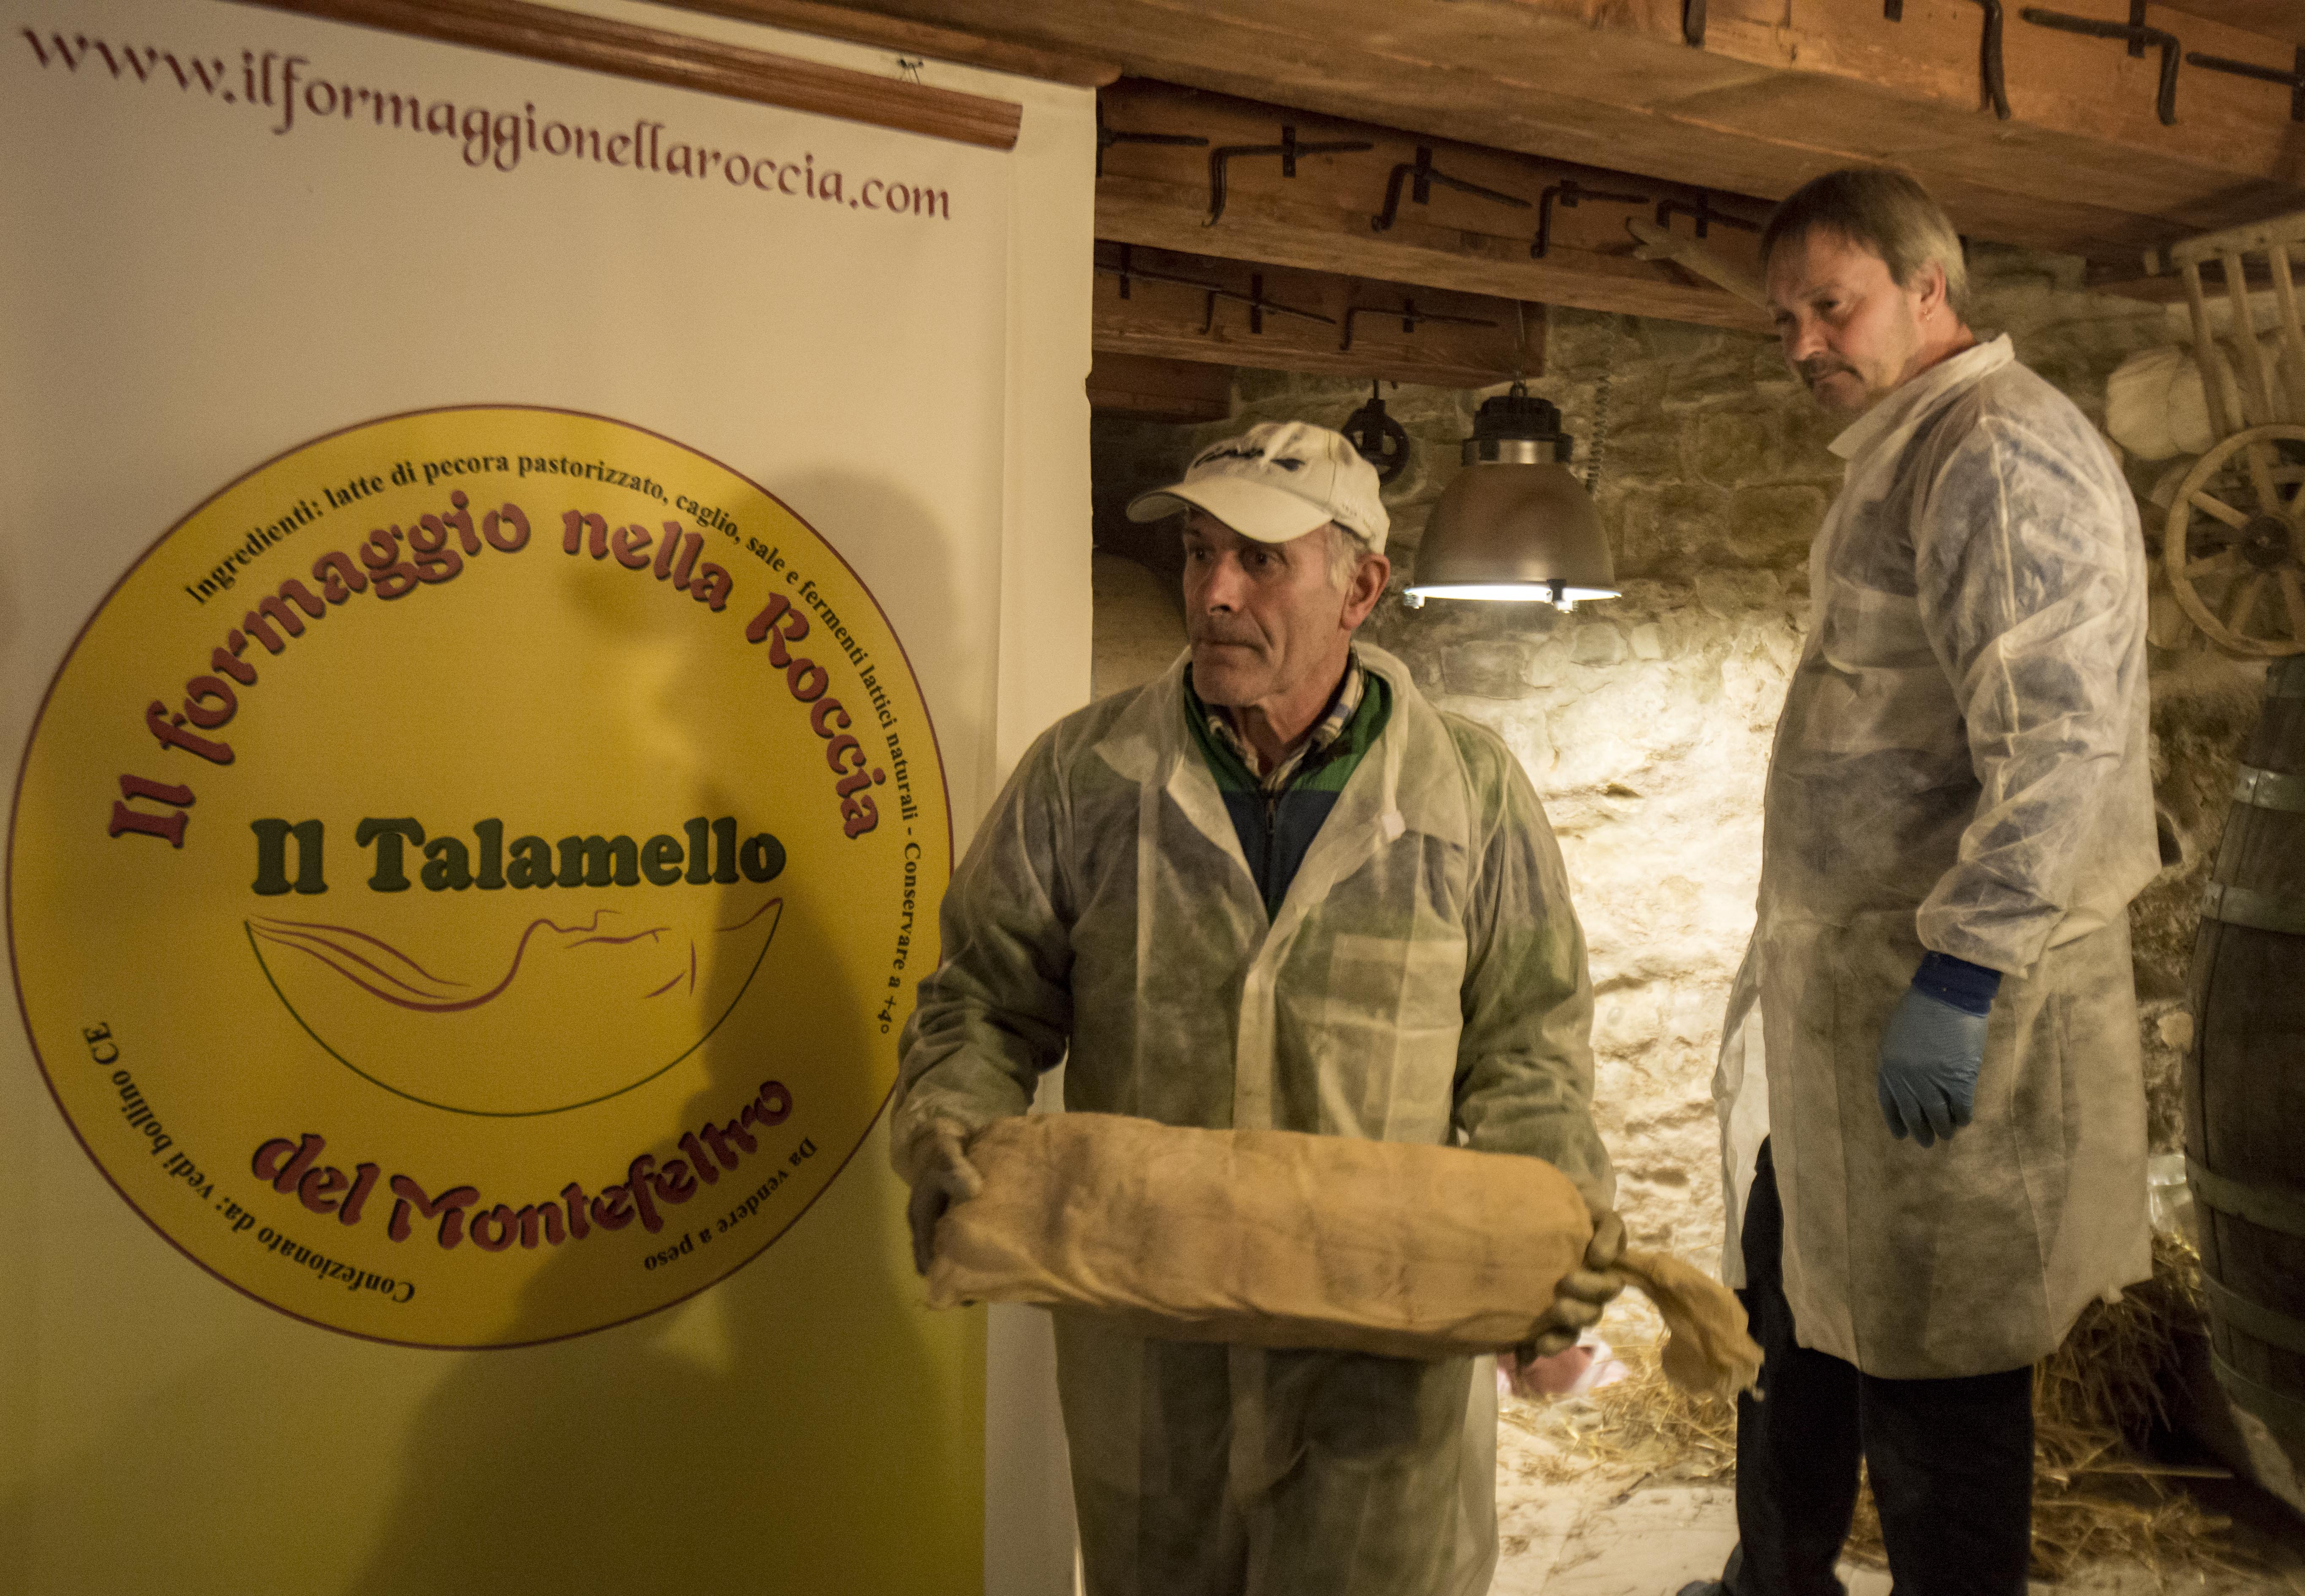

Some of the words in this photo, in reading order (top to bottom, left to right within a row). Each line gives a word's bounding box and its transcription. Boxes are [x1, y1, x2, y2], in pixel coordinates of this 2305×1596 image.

[21, 26, 951, 220] www.ilformaggionellaroccia.com
[323, 475, 384, 509] latte
[391, 460, 418, 486] di
[423, 455, 509, 486] pecora
[518, 454, 668, 506] pastorizzato,
[676, 494, 741, 545] caglio,
[185, 499, 324, 604] Ingredienti:
[561, 509, 734, 612] nella
[746, 536, 786, 572] sale
[786, 570, 799, 585] e
[146, 490, 531, 766] formaggio
[798, 580, 869, 667] fermenti
[745, 591, 887, 839] Roccia
[859, 665, 898, 730] lattici
[886, 733, 918, 821] naturali
[108, 774, 196, 849] Il
[249, 817, 329, 896] Il
[355, 816, 787, 893] Talamello
[893, 842, 921, 970] Conservare
[888, 976, 901, 988] a
[82, 1021, 119, 1065] CE
[112, 1070, 173, 1156] bollino
[163, 1151, 214, 1200] vedi
[252, 1133, 381, 1227] del
[387, 1080, 793, 1252] Montefeltro
[788, 1137, 818, 1167] Da
[216, 1197, 256, 1233] da:
[718, 1170, 788, 1233] vendere
[257, 1227, 416, 1303] Confezionato
[644, 1234, 694, 1270] peso
[699, 1228, 713, 1244] a
